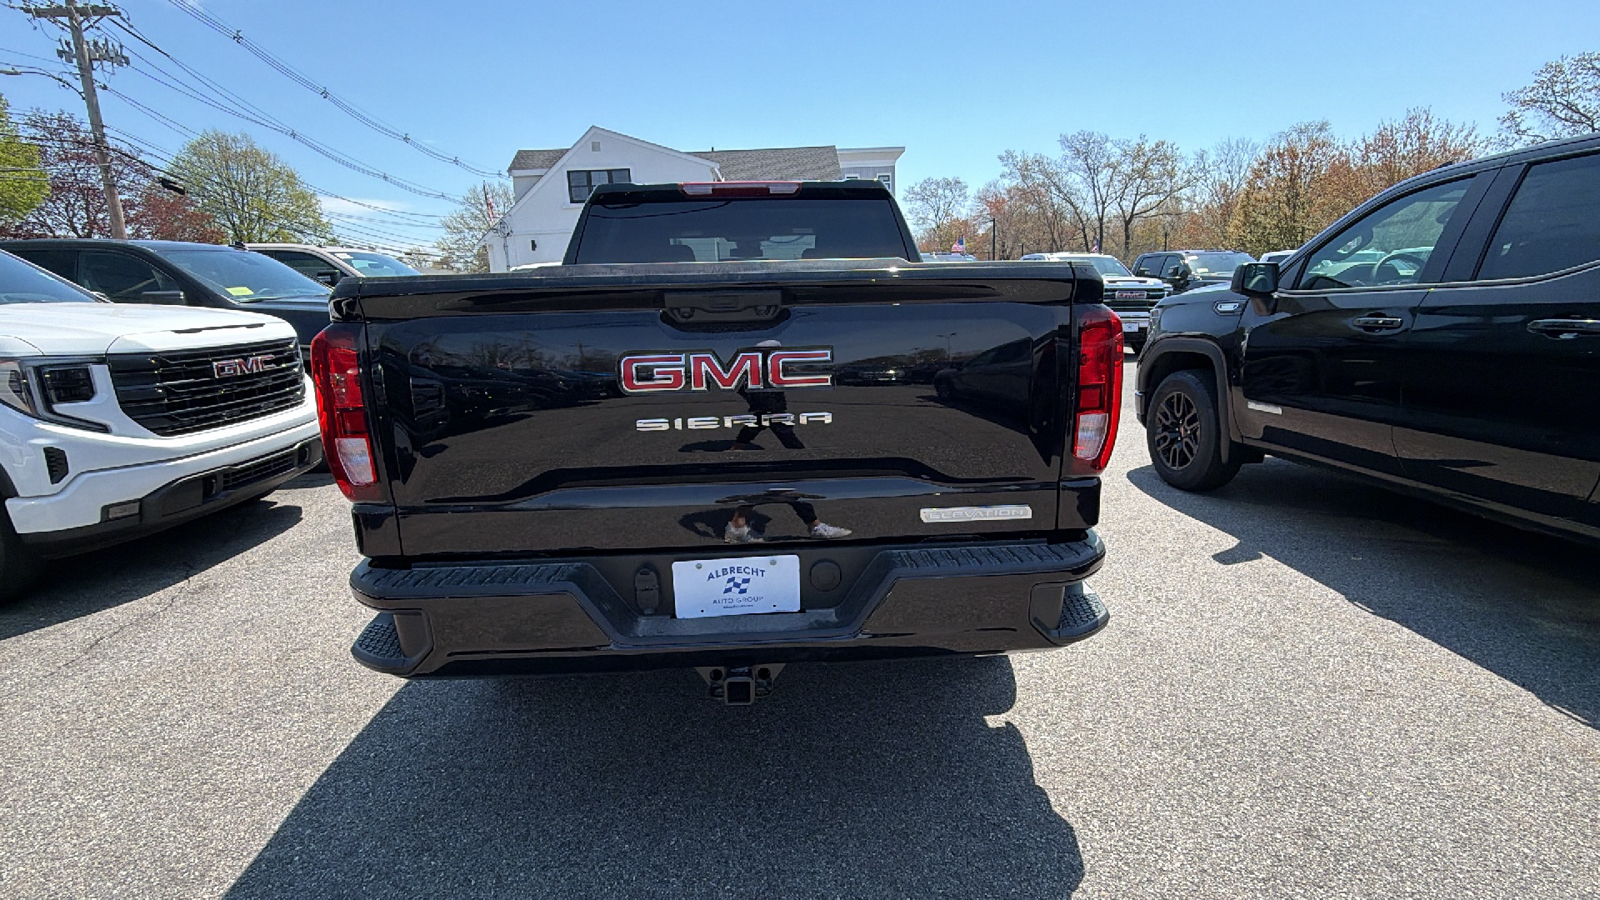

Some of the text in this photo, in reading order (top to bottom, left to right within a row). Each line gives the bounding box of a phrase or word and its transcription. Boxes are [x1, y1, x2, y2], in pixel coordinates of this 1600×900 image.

[213, 355, 276, 378] GMC
[621, 350, 832, 390] GMC
[636, 412, 832, 431] SIERRA
[929, 508, 1023, 519] ELEVATION
[707, 566, 766, 581] ALBRECHT
[736, 596, 764, 604] GROUP
